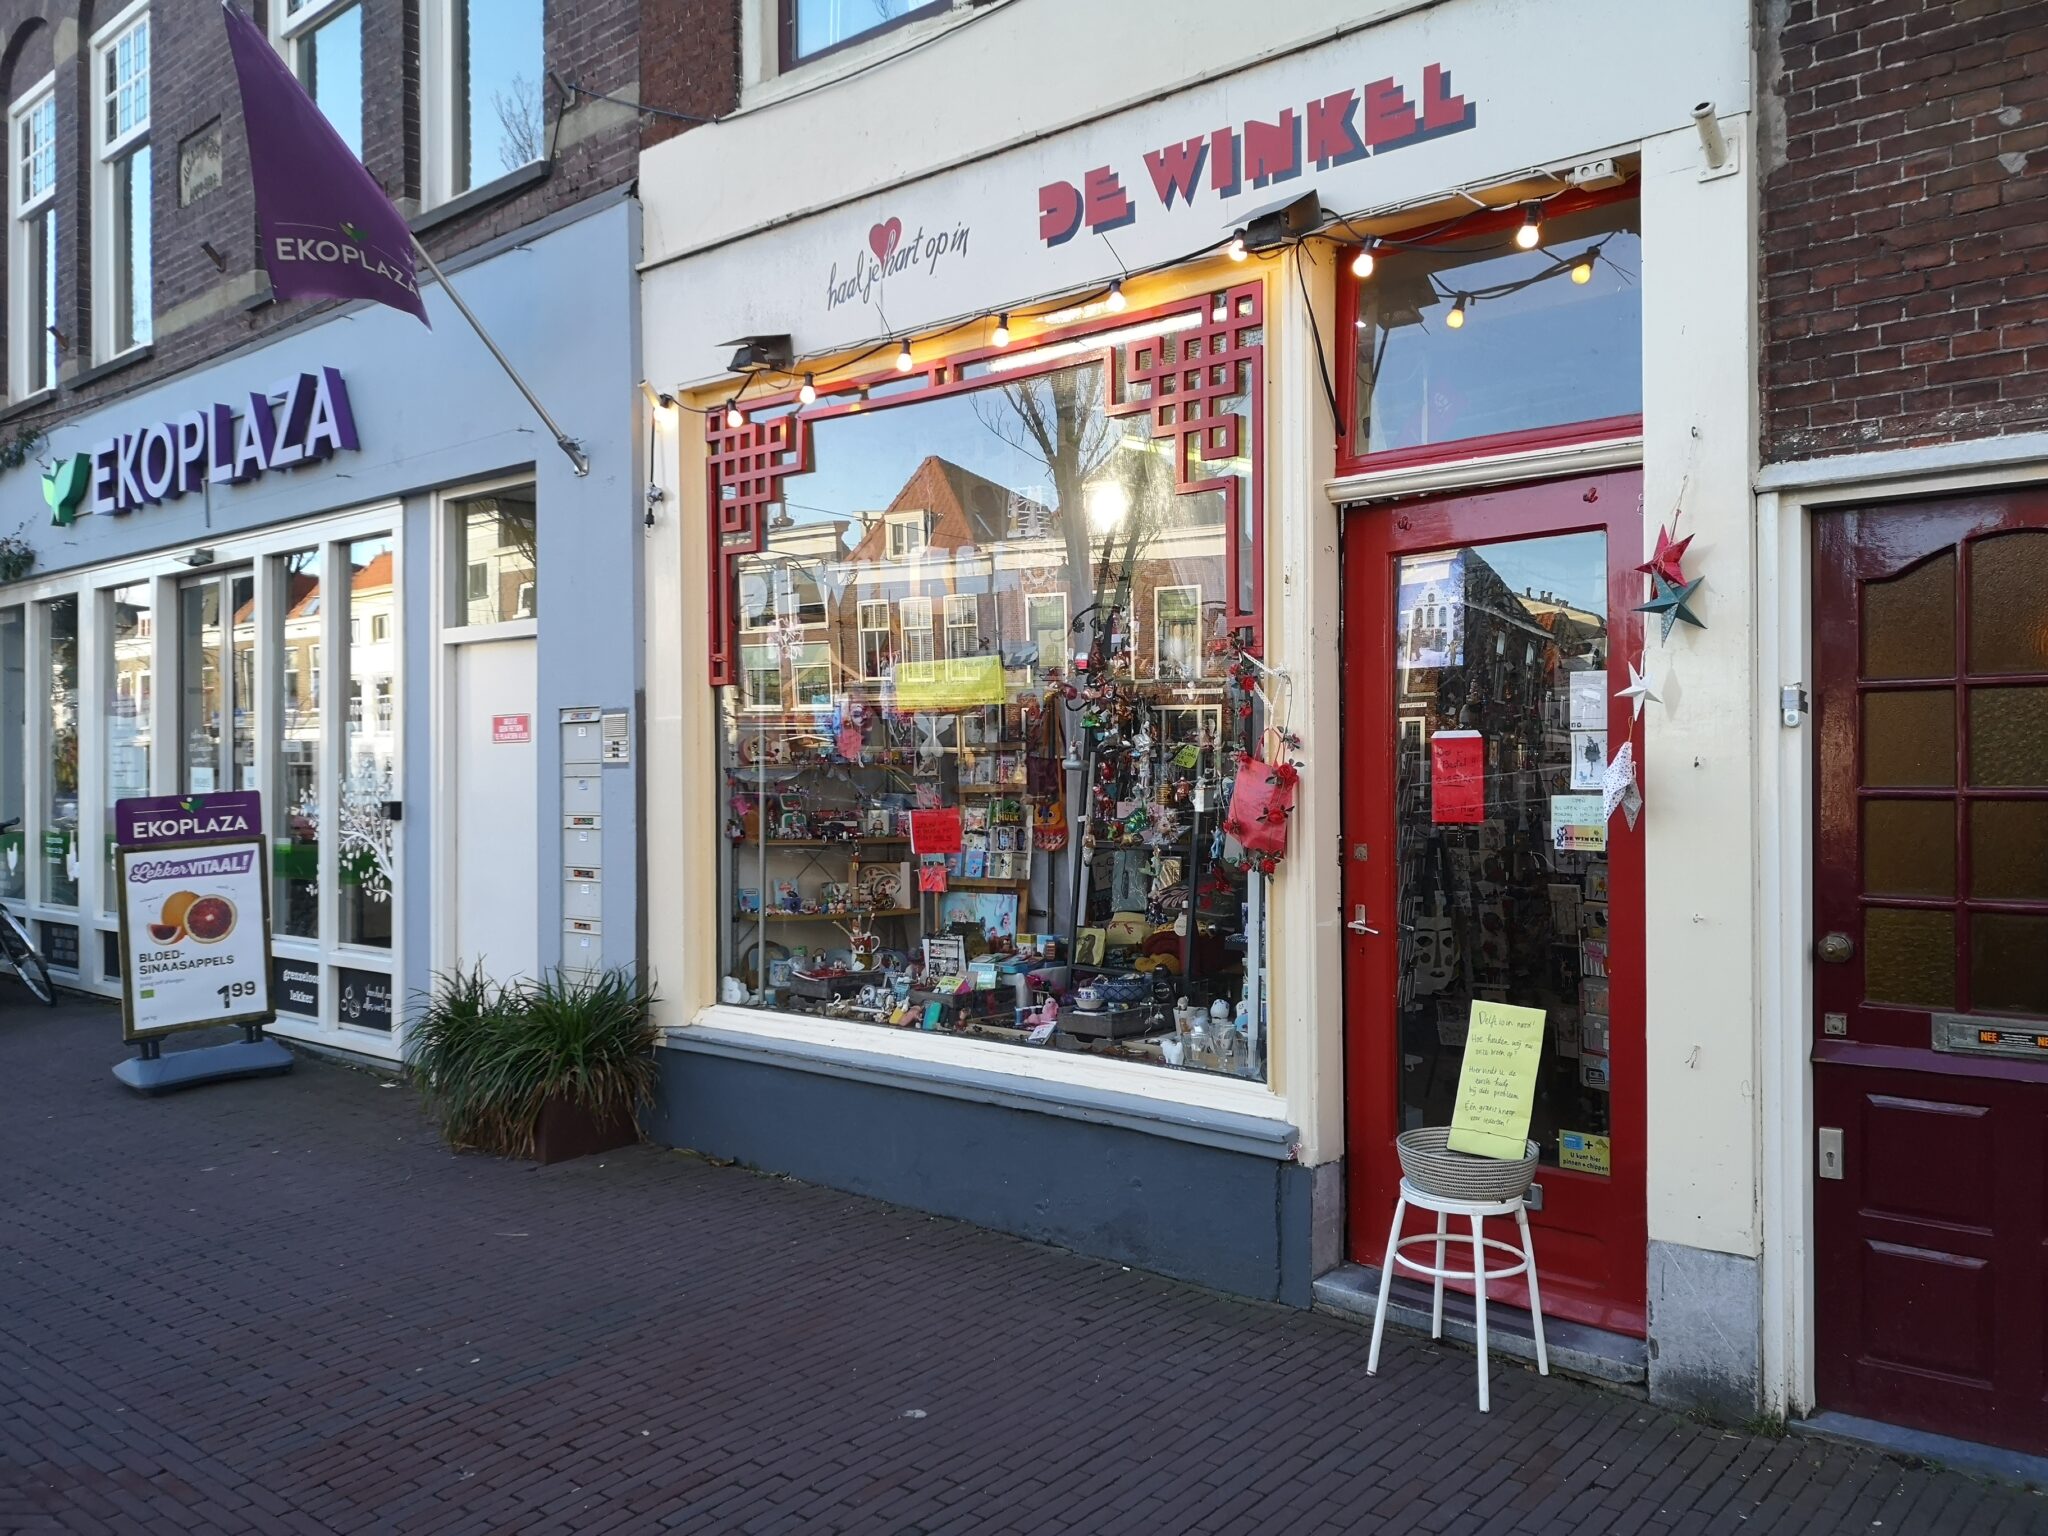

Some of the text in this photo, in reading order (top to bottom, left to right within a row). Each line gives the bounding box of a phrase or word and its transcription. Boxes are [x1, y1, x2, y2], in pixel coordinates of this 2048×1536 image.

[1038, 62, 1477, 248] DE WINKEL
[275, 237, 421, 300] EKOPLAZA
[827, 221, 970, 311] haal je hart op in
[92, 365, 361, 516] EKOPLAZA
[133, 815, 248, 839] EKOPLAZA
[131, 855, 249, 882] Lekker VITAAL!
[139, 950, 185, 963] BLOED-
[139, 955, 235, 975] SINAASAPPELS
[1981, 1031, 1997, 1041] NEE
[2038, 1036, 2048, 1047] NE
